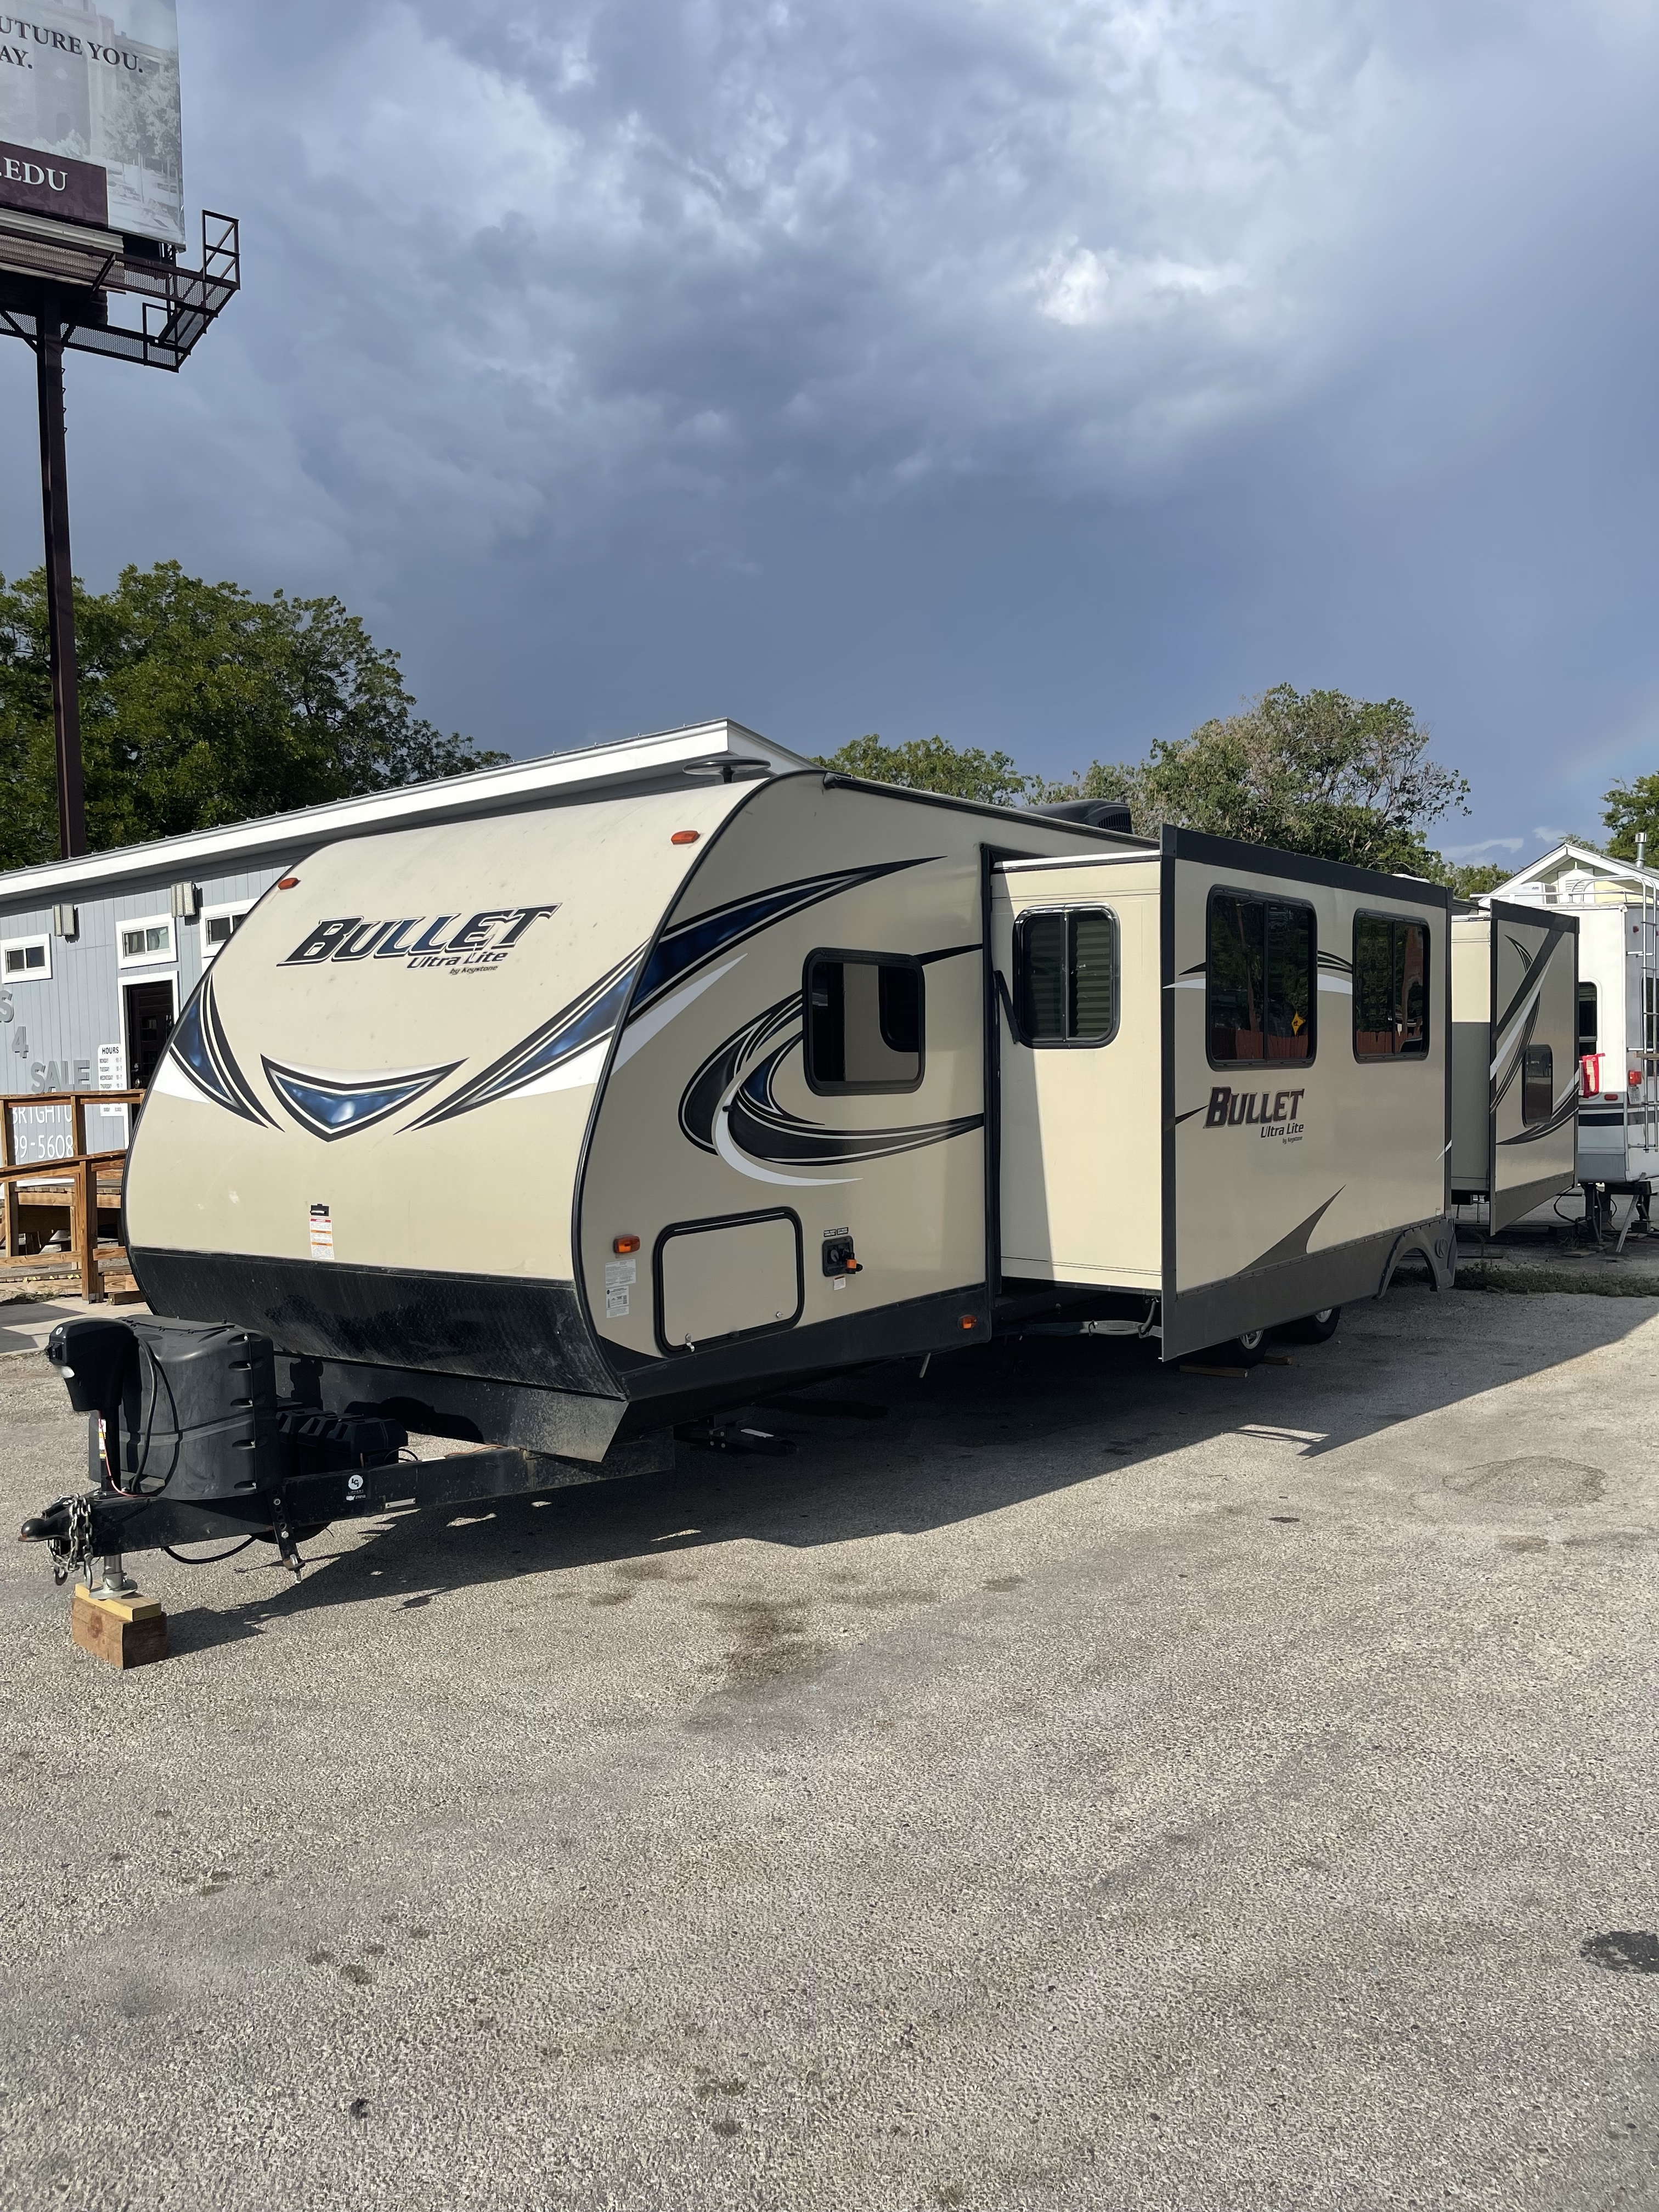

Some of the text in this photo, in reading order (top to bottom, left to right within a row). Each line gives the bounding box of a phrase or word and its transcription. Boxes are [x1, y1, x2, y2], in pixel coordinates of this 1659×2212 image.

[87, 41, 143, 73] YOU.
[276, 902, 563, 967] BULLET
[407, 951, 509, 969] Ultra Lite
[461, 966, 498, 974] Keystone
[12, 1026, 29, 1058] 4
[102, 1046, 119, 1054] HOURS
[31, 1059, 91, 1093] SALE
[1203, 1086, 1305, 1129] BULLET
[1261, 1122, 1304, 1138] Ultra Lite
